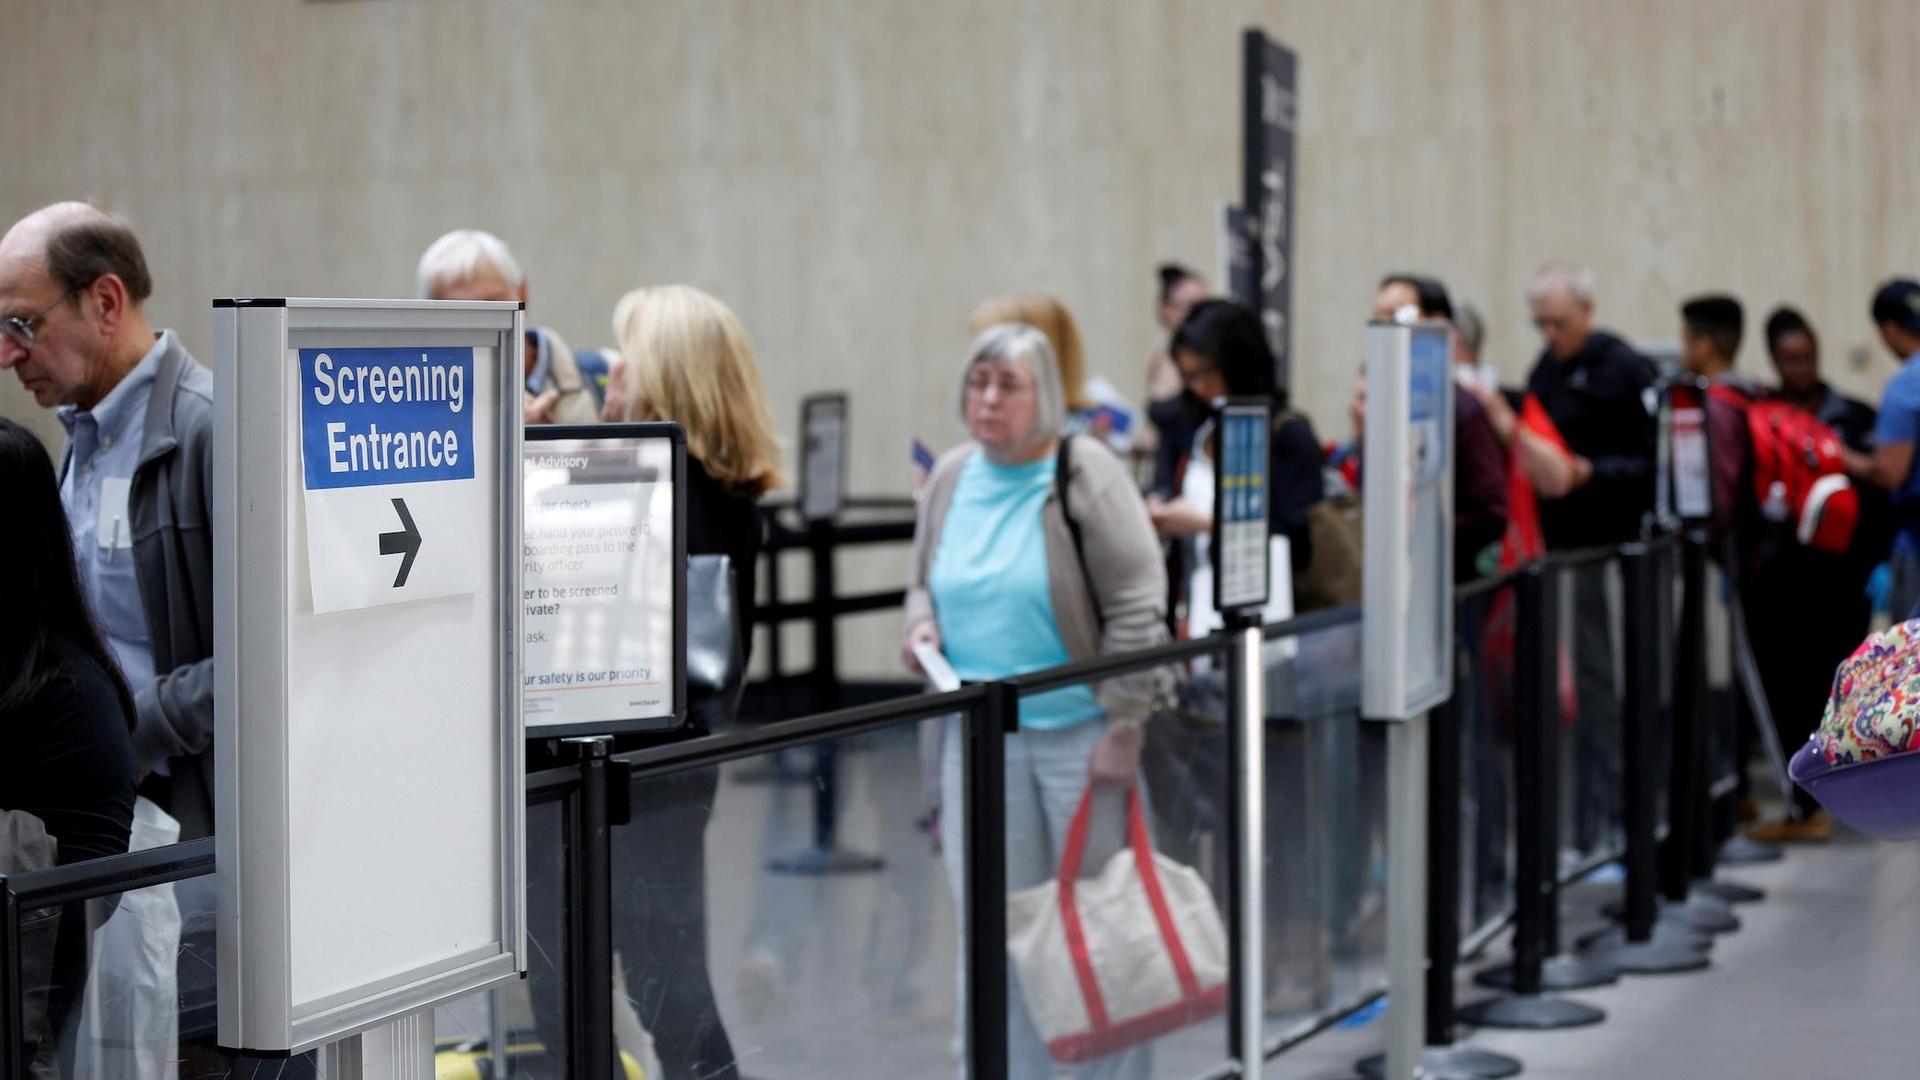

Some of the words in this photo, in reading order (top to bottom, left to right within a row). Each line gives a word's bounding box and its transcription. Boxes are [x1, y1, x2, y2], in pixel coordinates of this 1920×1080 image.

[314, 353, 464, 413] Screening
[327, 422, 459, 473] Entrance
[524, 456, 537, 468] el
[539, 456, 589, 470] Advisory
[524, 530, 536, 540] se
[539, 527, 567, 539] hand
[570, 527, 594, 541] your
[599, 524, 637, 541] picture
[524, 543, 574, 558] boarding
[576, 544, 600, 557] pass
[604, 542, 615, 552] to
[618, 541, 636, 552] the
[525, 560, 544, 574] rity
[524, 590, 535, 600] er
[538, 588, 549, 599] to
[552, 586, 566, 598] be
[569, 584, 619, 598] screened
[526, 603, 560, 616] ivate?
[524, 676, 537, 685] ur
[538, 672, 573, 685] safety
[576, 671, 585, 682] is
[588, 670, 608, 682] our
[609, 666, 651, 681] priority
